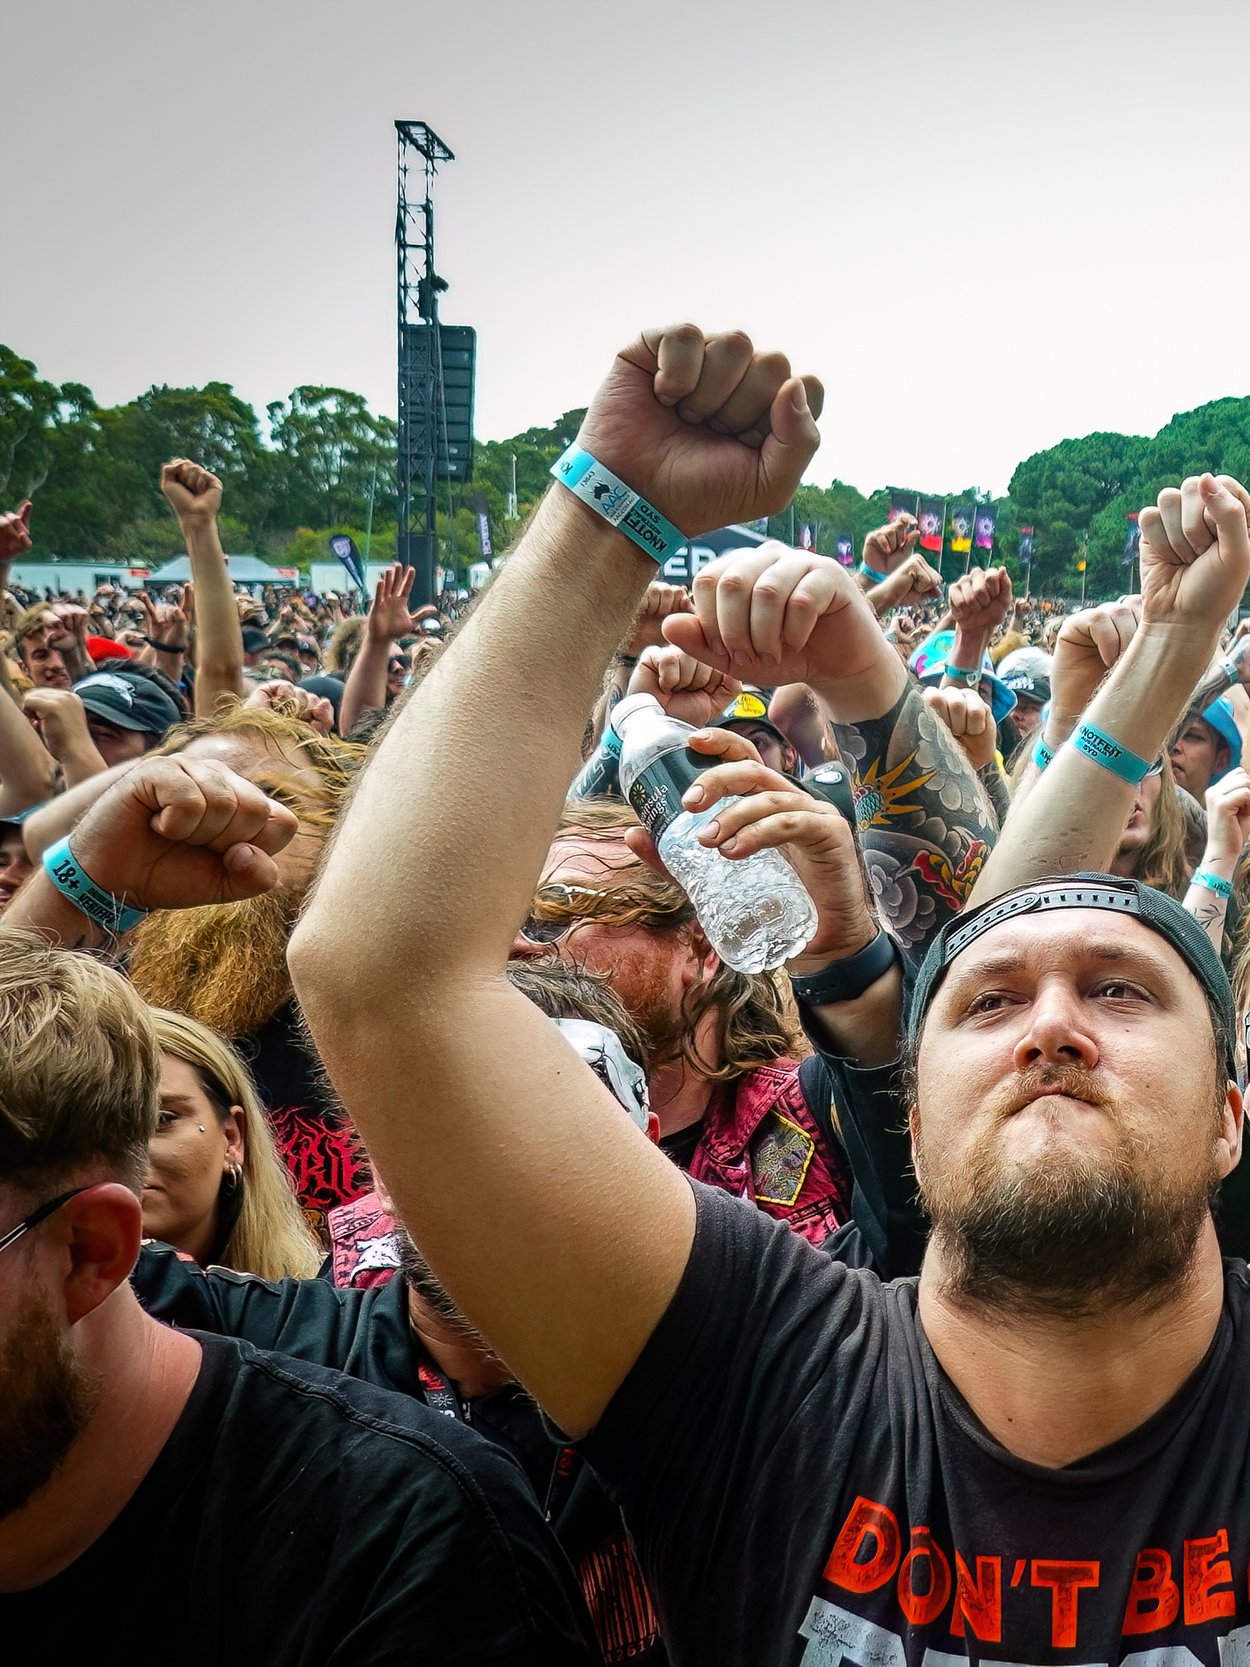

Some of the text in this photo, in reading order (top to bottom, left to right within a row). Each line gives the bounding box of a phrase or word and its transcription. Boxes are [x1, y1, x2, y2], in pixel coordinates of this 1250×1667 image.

[1083, 745, 1098, 757] SYD
[53, 859, 80, 889] 18+
[822, 1495, 1100, 1648] DON'T
[1122, 1528, 1236, 1636] BE
